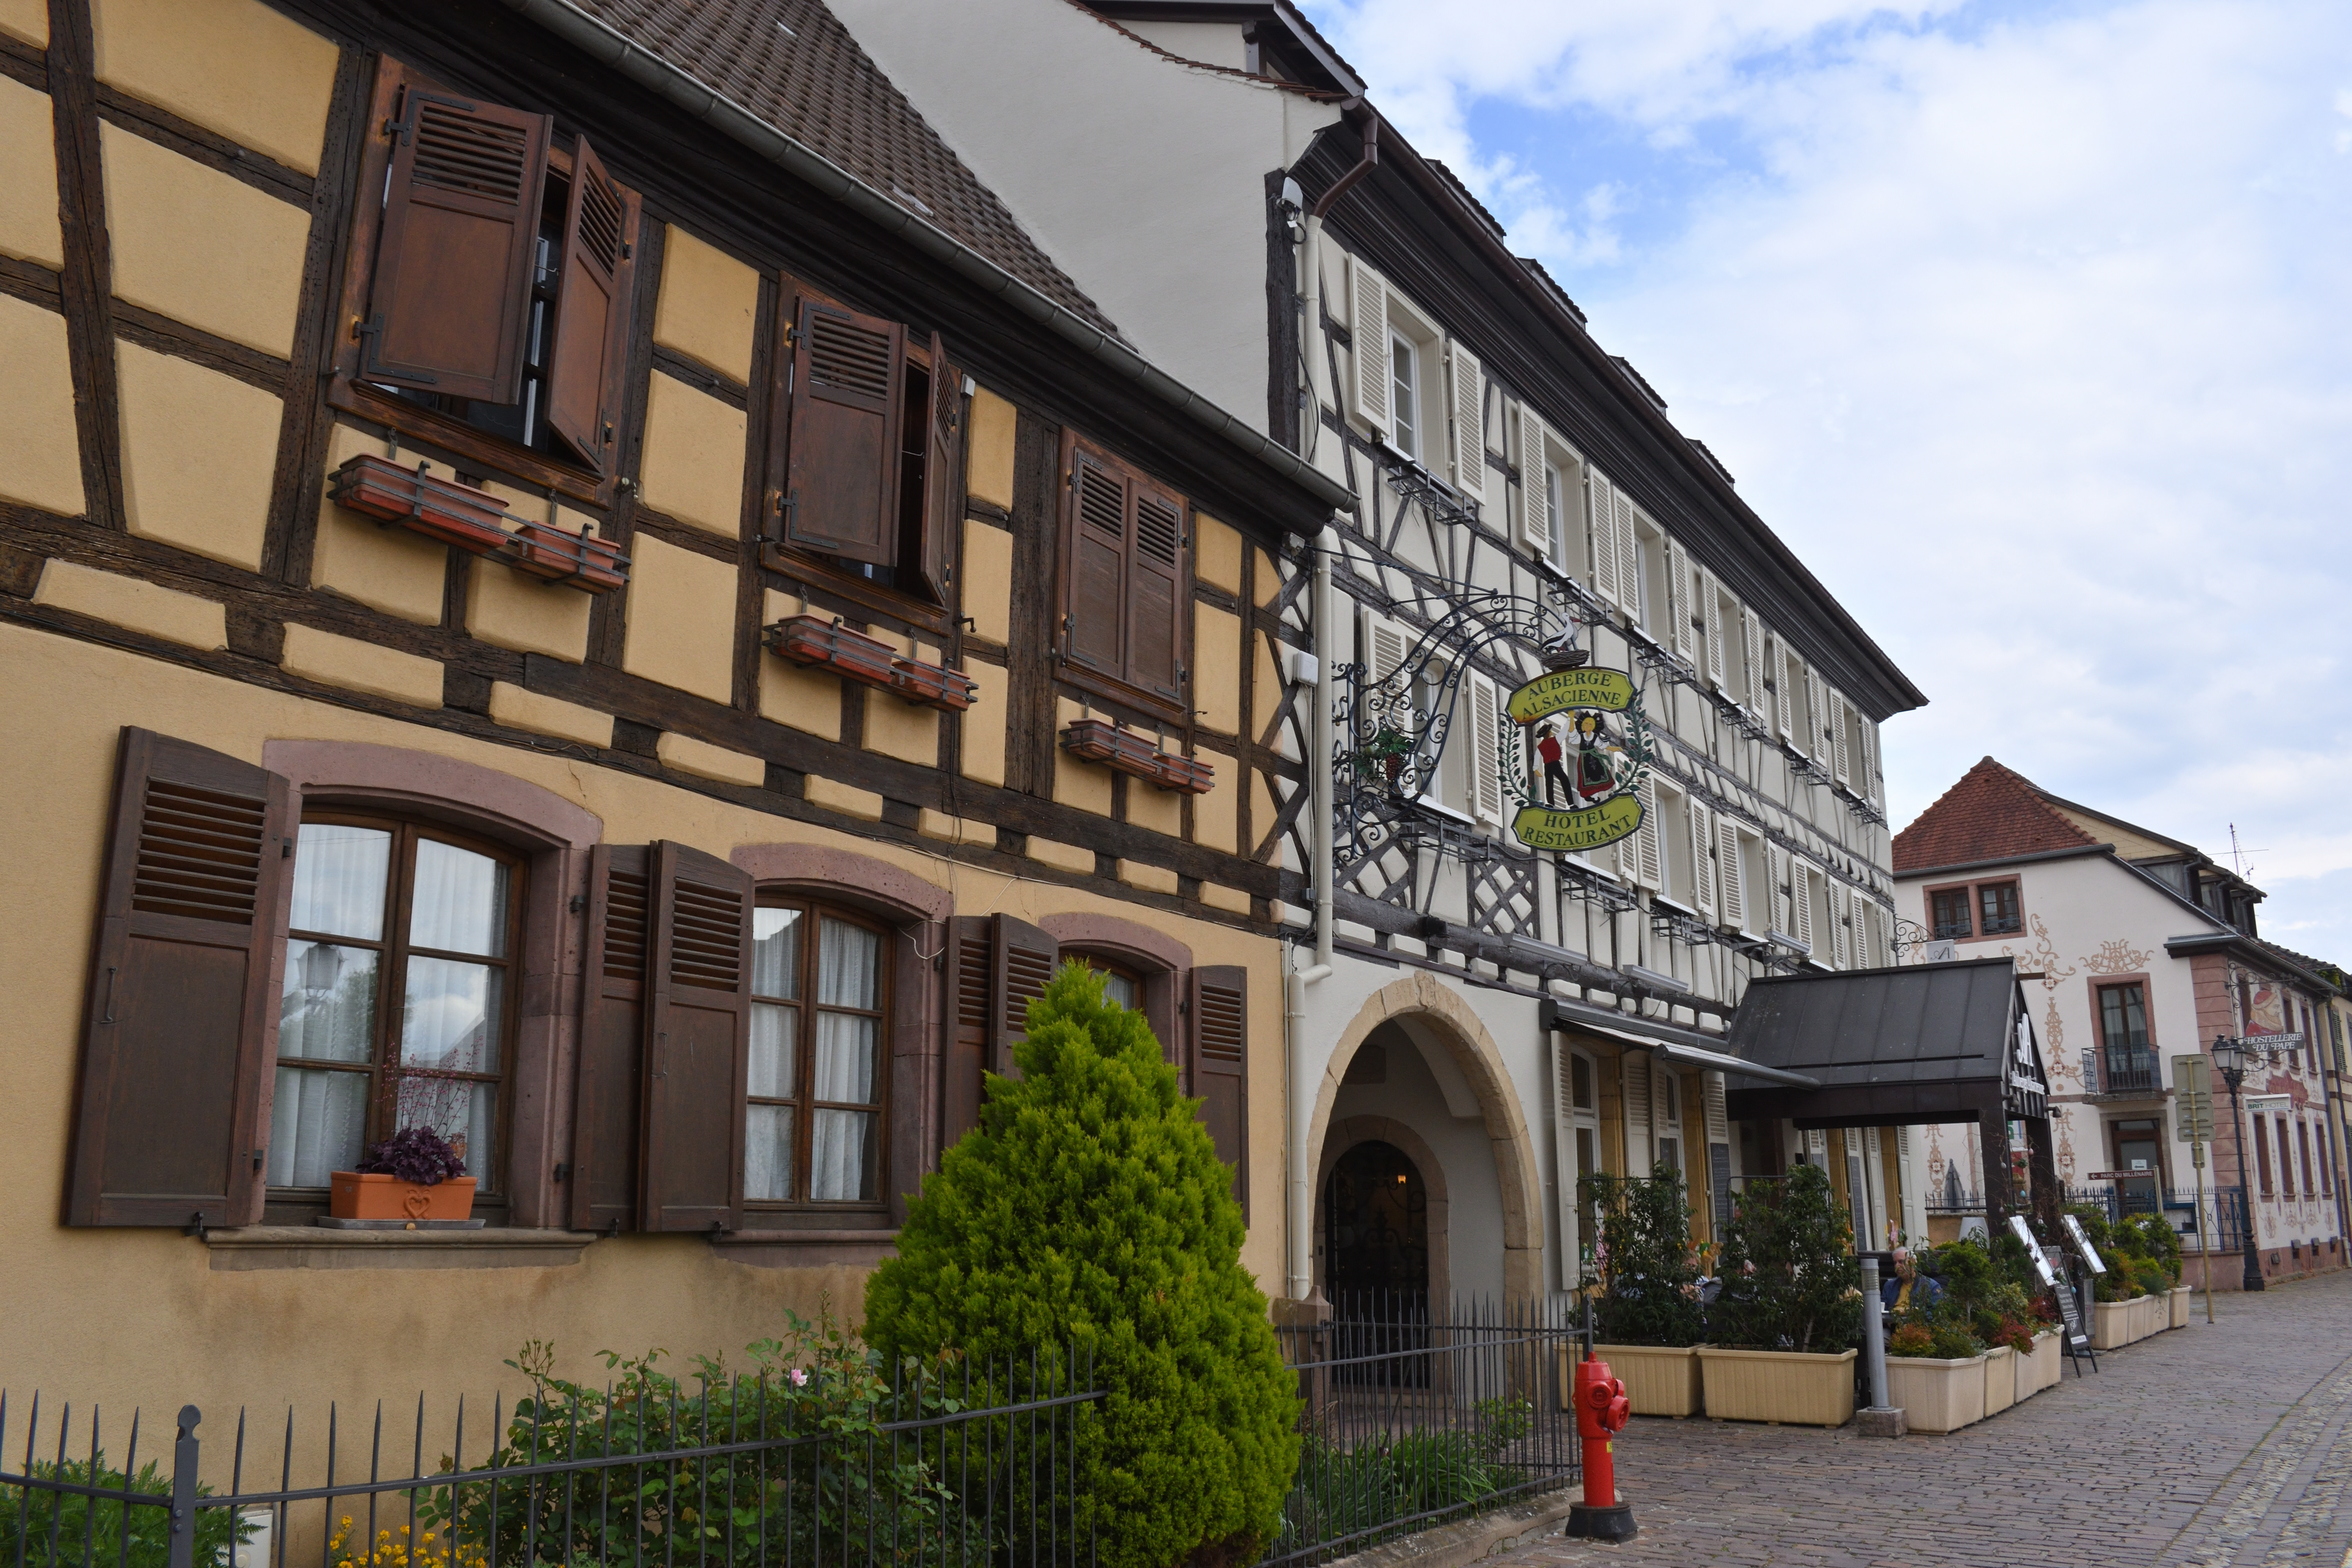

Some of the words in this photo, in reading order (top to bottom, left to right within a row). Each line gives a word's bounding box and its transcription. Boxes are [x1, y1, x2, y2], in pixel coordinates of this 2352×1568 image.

[1528, 672, 1612, 701] AUBERGE
[1523, 689, 1621, 719] ALSACIENNE
[1523, 815, 1631, 846] RESTAURANT
[1544, 809, 1610, 829] HOTEL
[2244, 1033, 2302, 1044] HOSTELLERIE
[2270, 1041, 2295, 1050] PAPE
